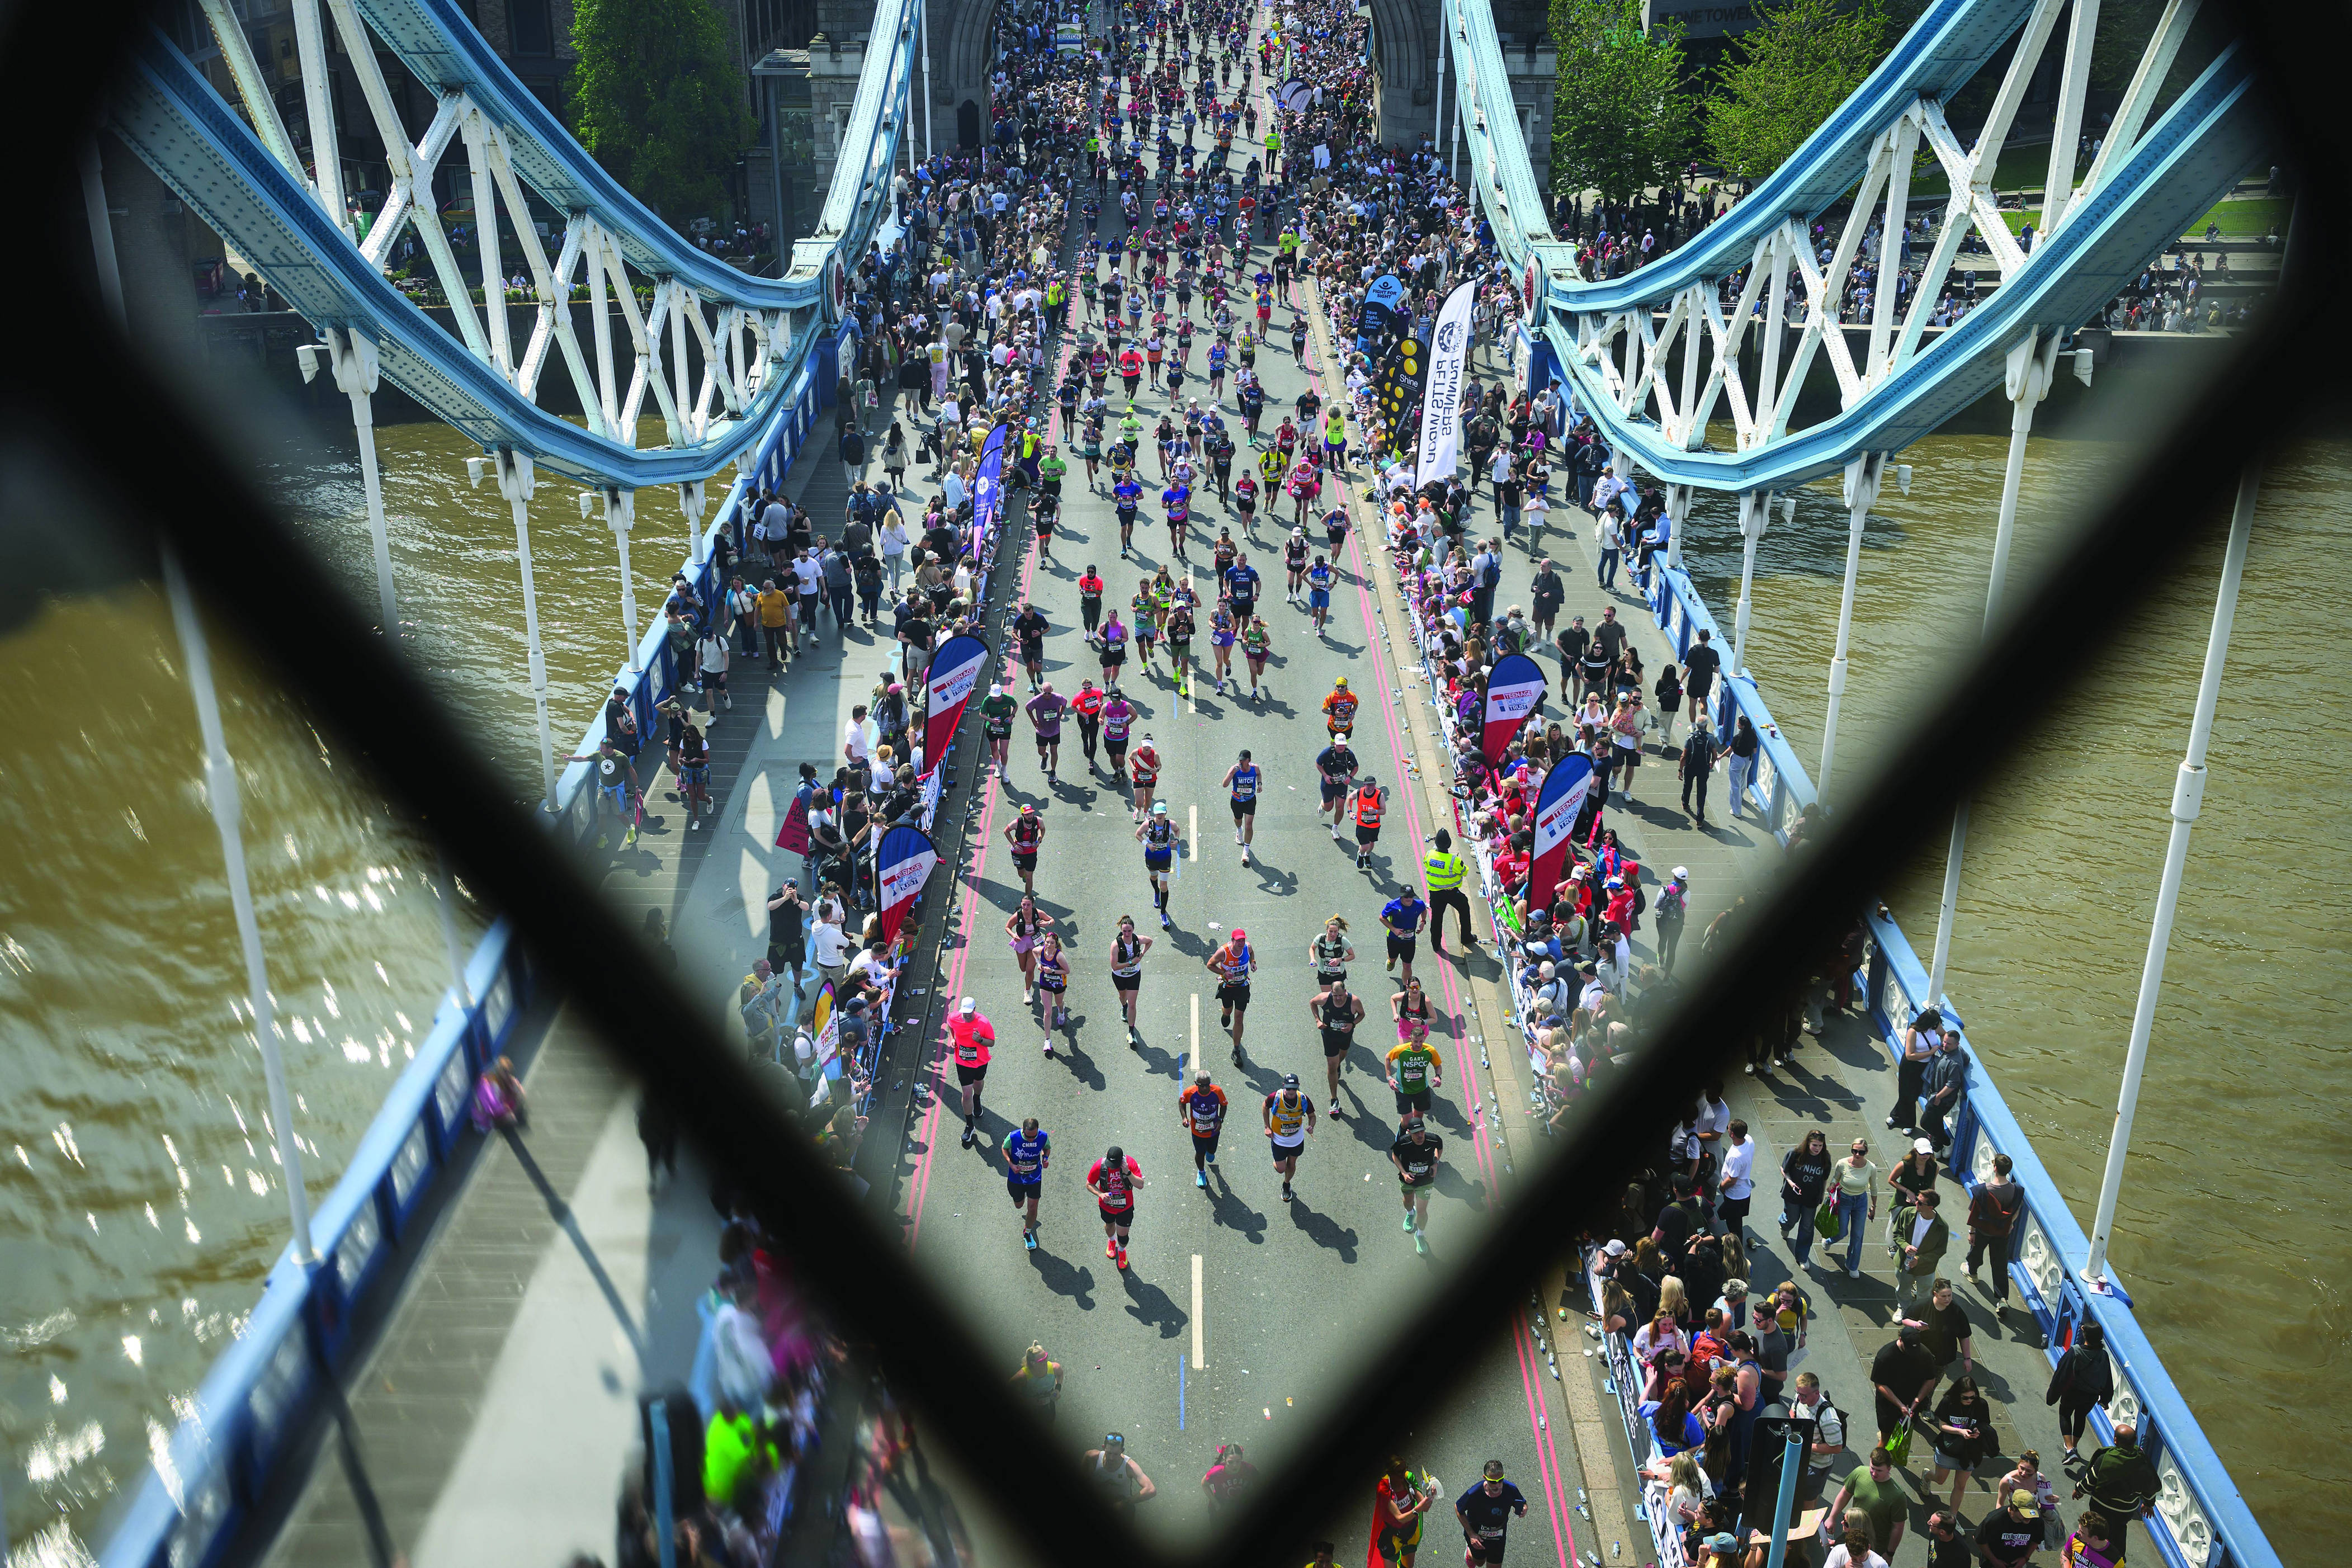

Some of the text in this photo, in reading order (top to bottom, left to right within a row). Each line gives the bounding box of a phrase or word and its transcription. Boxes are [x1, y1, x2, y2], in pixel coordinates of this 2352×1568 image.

[1673, 10, 1703, 23] ONE
[1704, 6, 1754, 22] TOWER
[1399, 374, 1419, 388] Shine
[946, 665, 976, 687] TEENAGE
[948, 675, 975, 689] CANCER
[952, 681, 972, 697] TRUST
[1504, 689, 1532, 699] TEENAGE
[1507, 697, 1531, 705] CANCER
[1553, 788, 1584, 817] TEENAGE
[1556, 802, 1580, 824] CANCE
[1559, 811, 1579, 829] TRUS
[900, 878, 918, 891] TUST
[1397, 1498, 1410, 1508] PAUL
[2074, 1551, 2089, 1566] YOUNG
